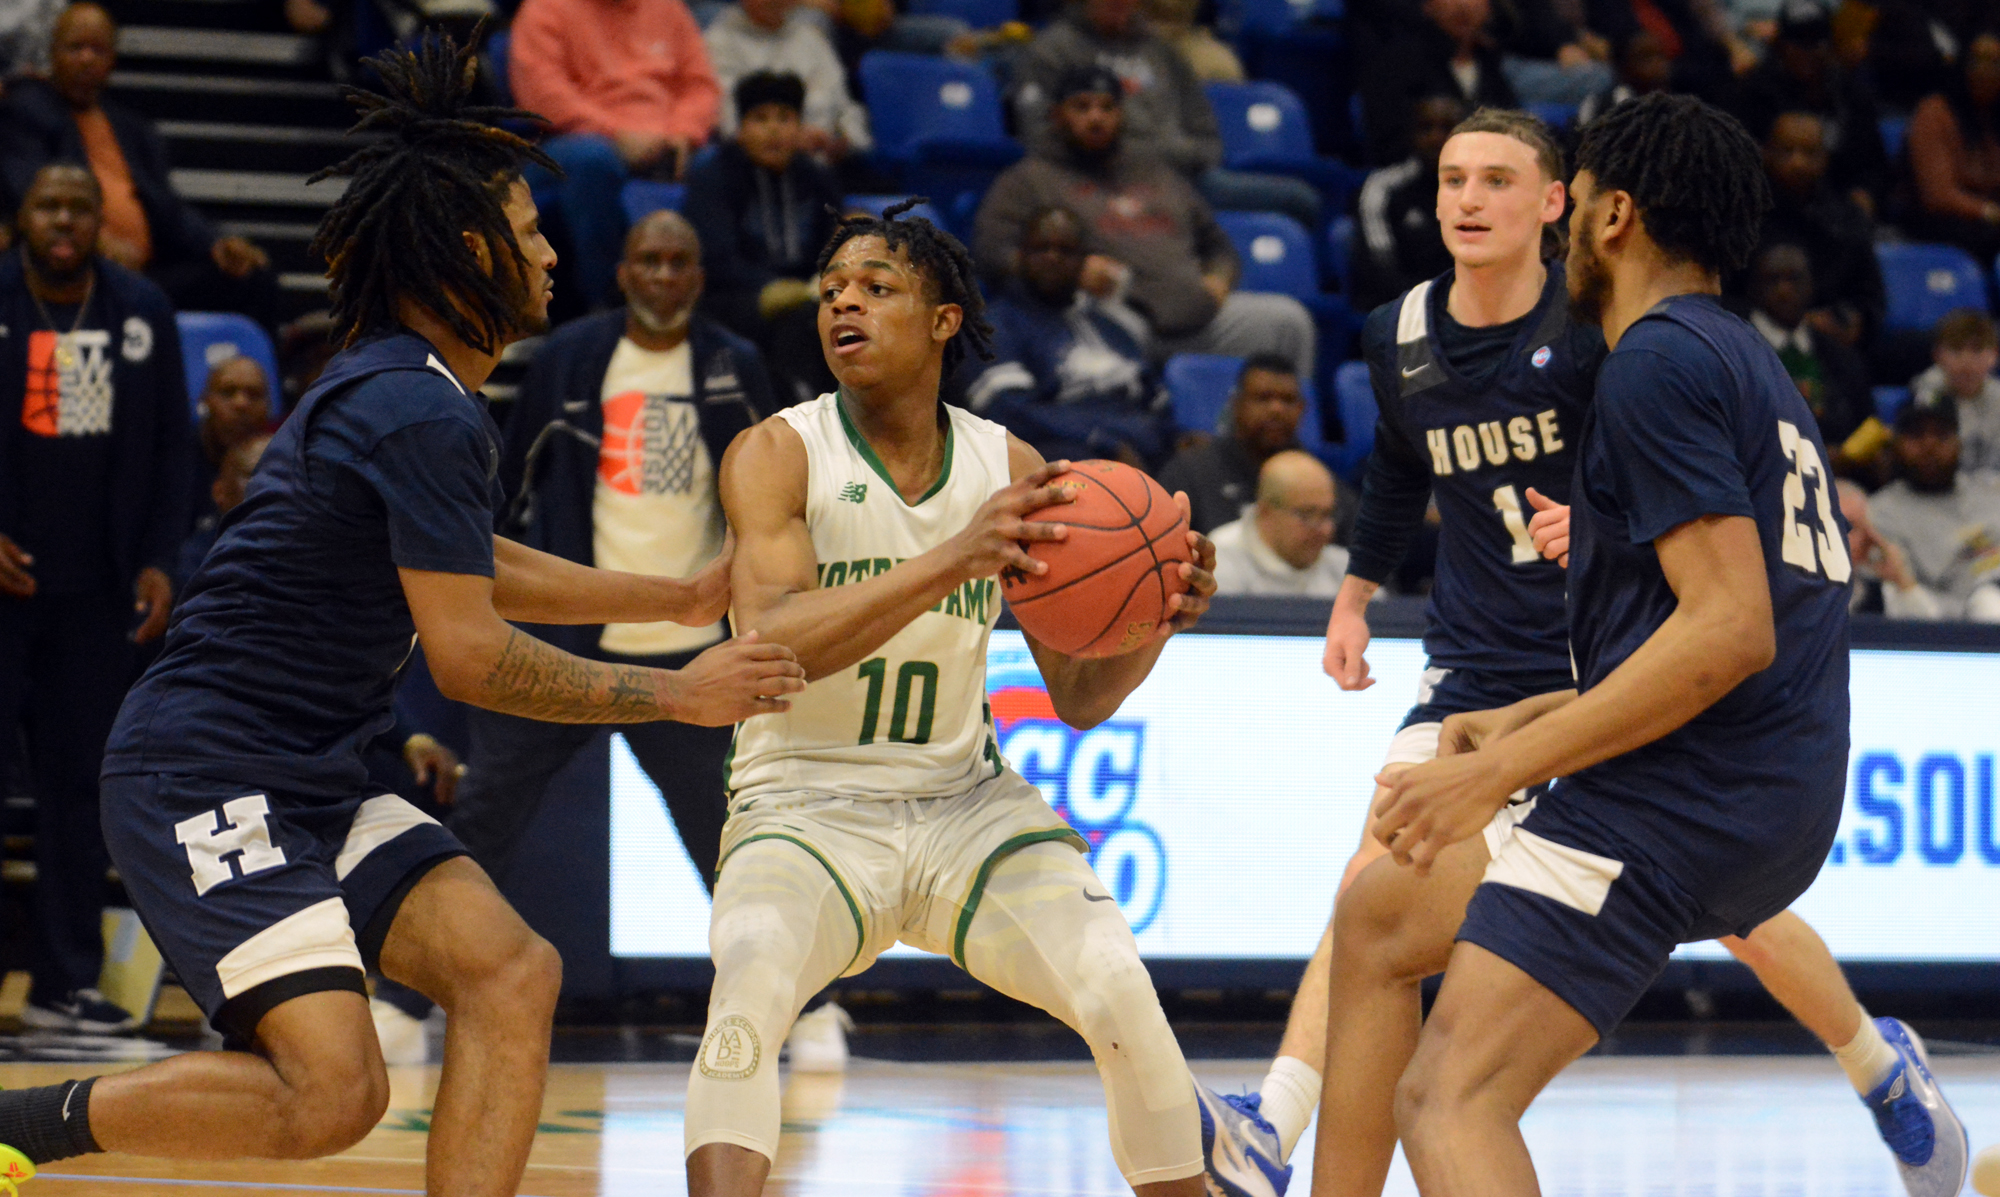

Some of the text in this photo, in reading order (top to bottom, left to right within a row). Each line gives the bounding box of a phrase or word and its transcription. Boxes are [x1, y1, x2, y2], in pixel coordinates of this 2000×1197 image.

[1426, 408, 1564, 476] HOUSE
[1777, 419, 1852, 584] 23
[929, 579, 995, 626] AM
[856, 656, 939, 746] 10
[175, 794, 287, 897] H
